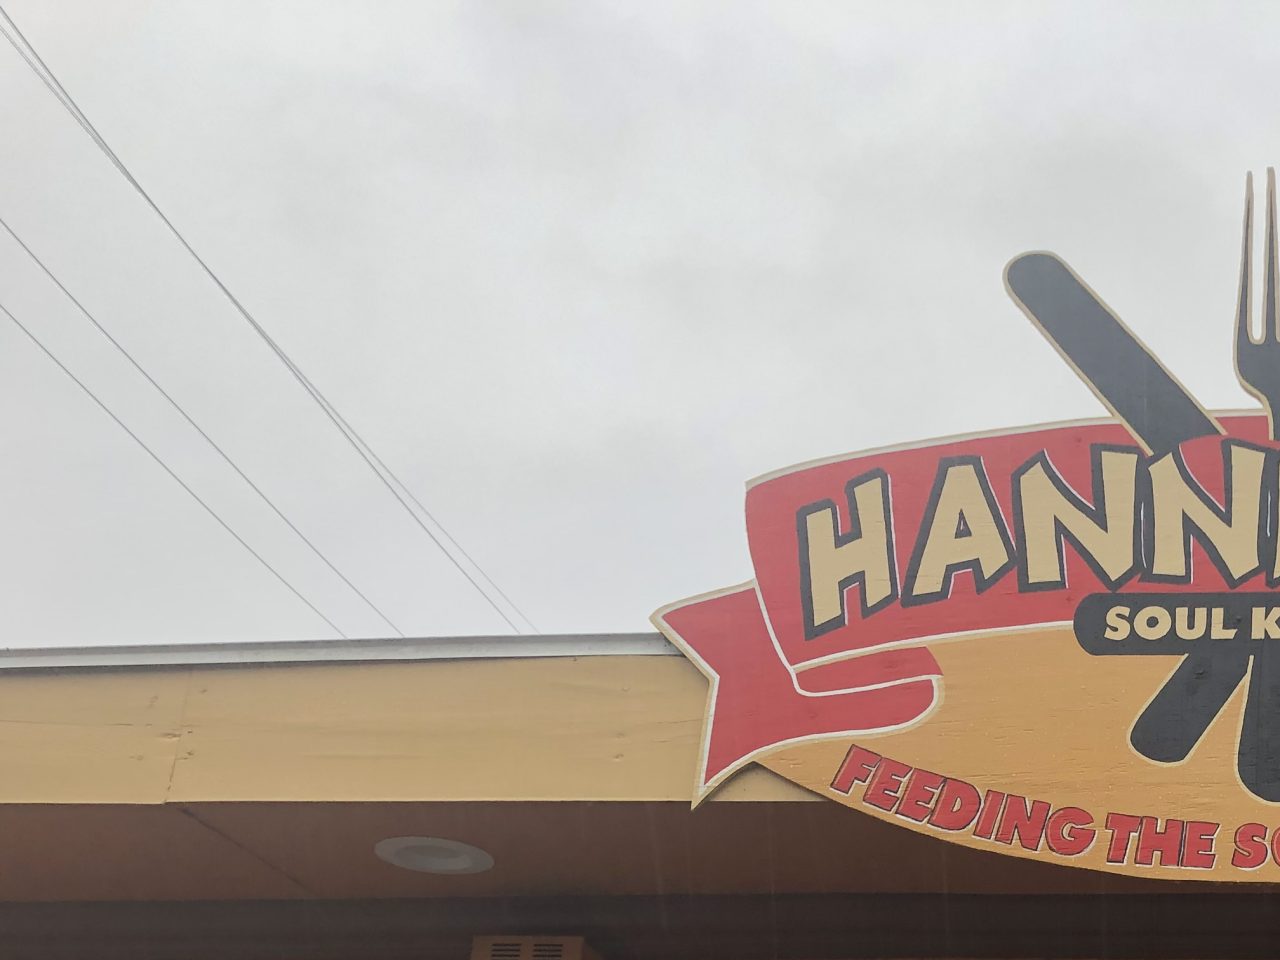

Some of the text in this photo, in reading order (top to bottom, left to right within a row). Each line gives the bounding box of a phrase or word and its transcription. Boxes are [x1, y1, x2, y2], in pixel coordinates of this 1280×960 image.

[1104, 605, 1237, 641] SOUL
[828, 744, 1096, 857] FEEDING
[1104, 812, 1221, 869] THE
